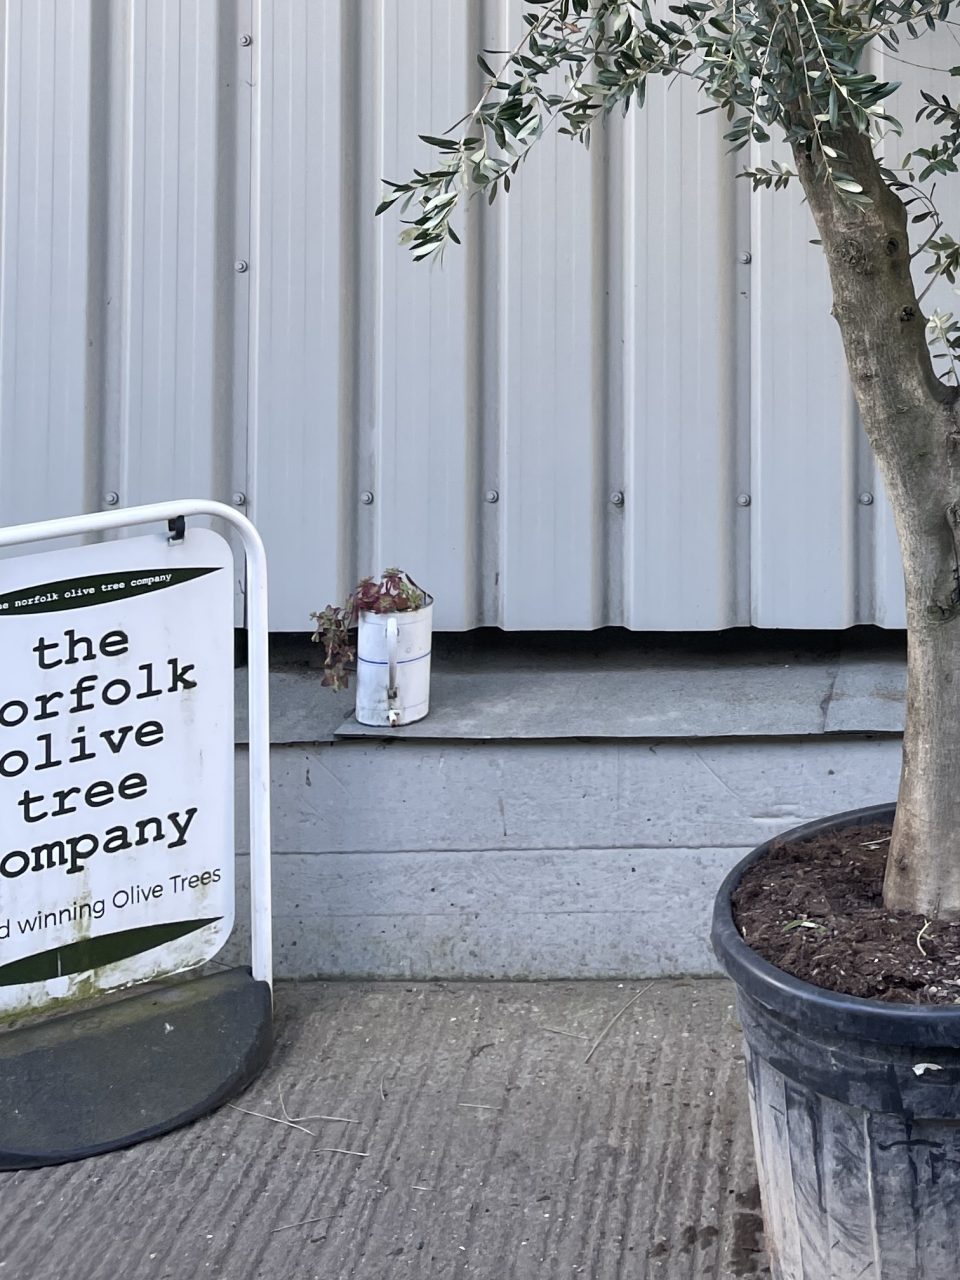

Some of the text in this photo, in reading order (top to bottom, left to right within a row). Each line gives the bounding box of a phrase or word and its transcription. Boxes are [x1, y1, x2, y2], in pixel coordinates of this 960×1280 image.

[14, 592, 59, 608] norfolk
[64, 587, 96, 599] olive
[100, 581, 125, 592] tree
[130, 572, 172, 587] company
[32, 629, 129, 670] the
[0, 720, 164, 778] olive
[18, 772, 148, 823] tree
[17, 899, 105, 934] winning
[112, 883, 164, 909] Olive
[169, 868, 221, 894] Trees
